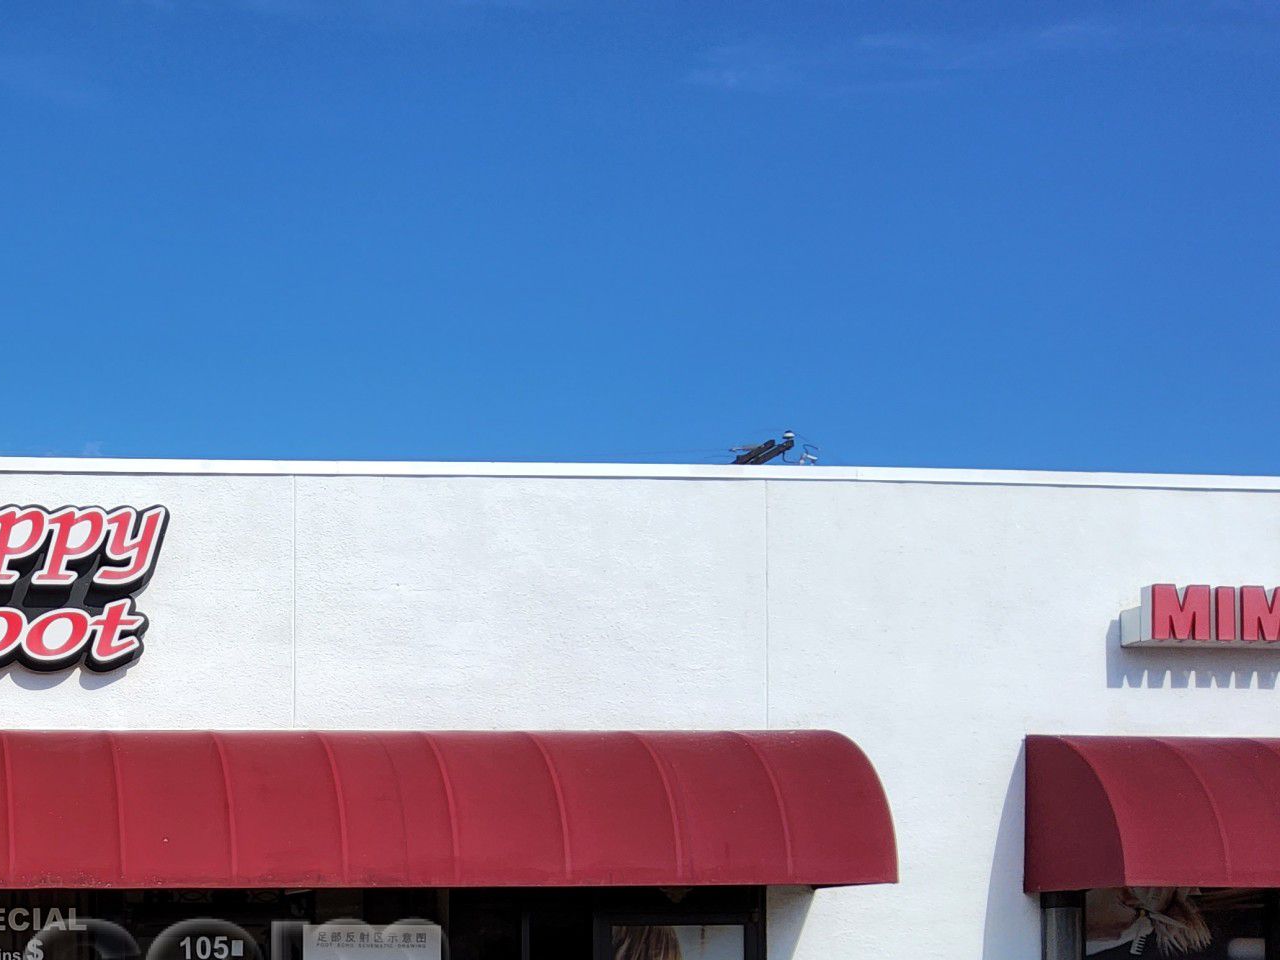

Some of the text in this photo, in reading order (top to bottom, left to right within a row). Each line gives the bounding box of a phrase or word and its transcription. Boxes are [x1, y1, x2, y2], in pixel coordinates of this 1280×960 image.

[1151, 584, 1280, 641] MIM
[179, 936, 229, 960] 105
[318, 931, 427, 943] 足部反射区示意图
